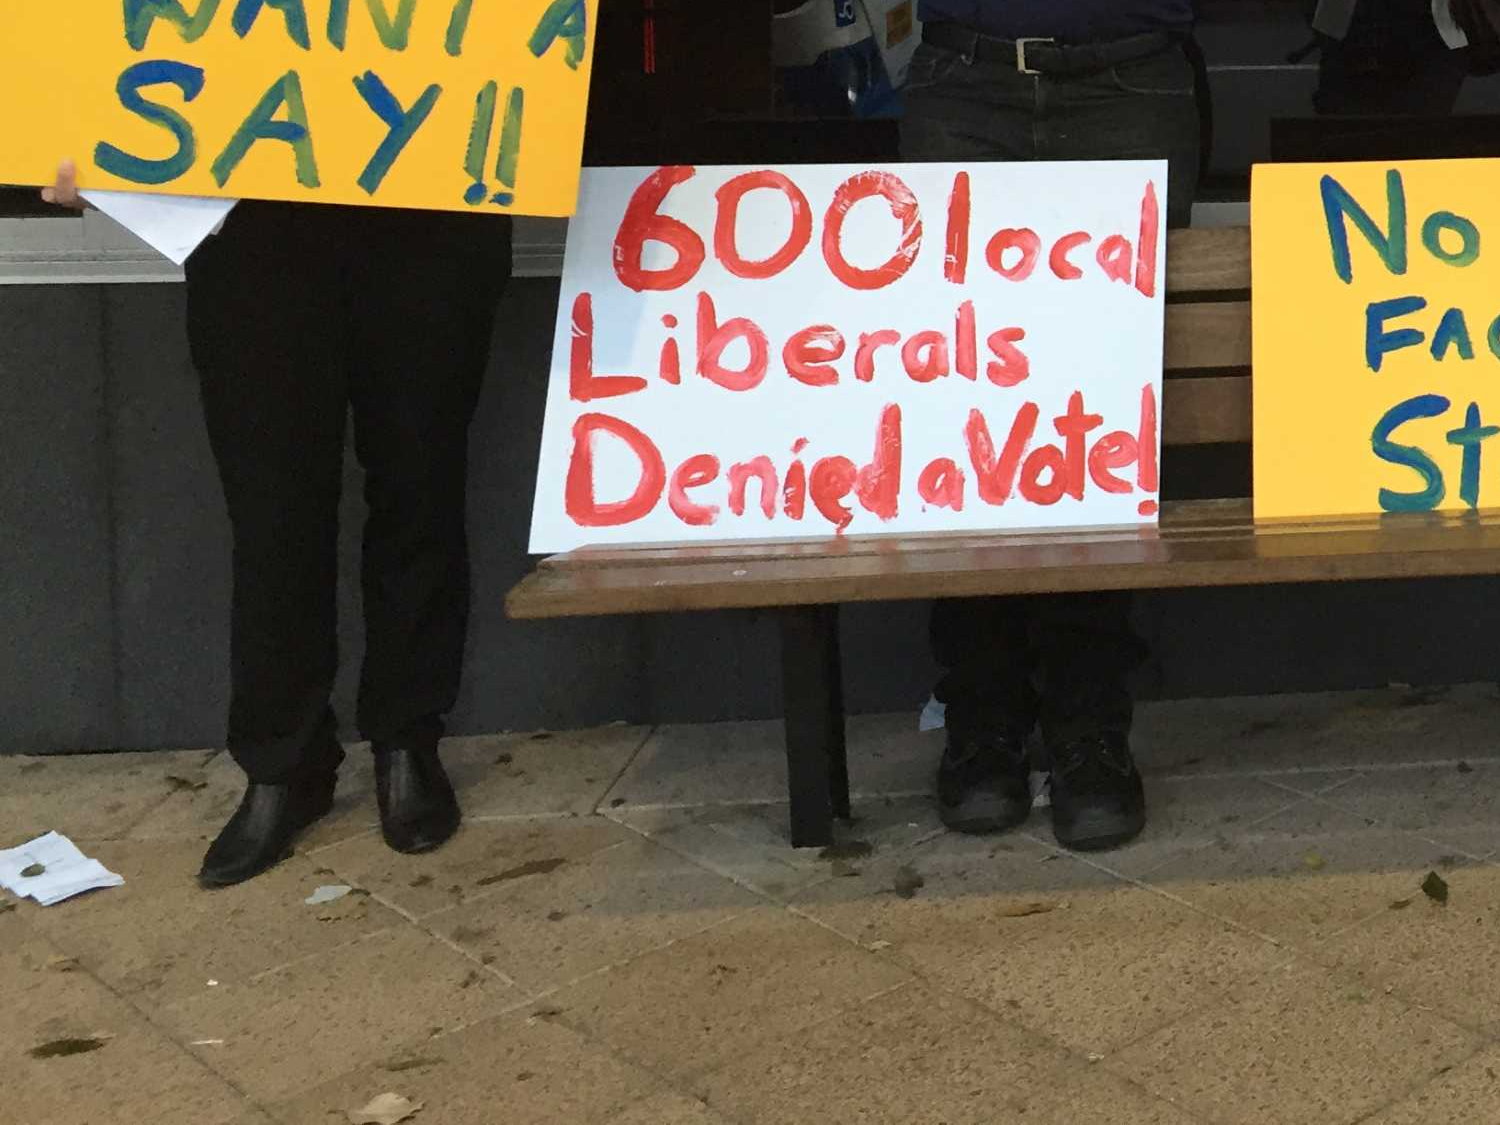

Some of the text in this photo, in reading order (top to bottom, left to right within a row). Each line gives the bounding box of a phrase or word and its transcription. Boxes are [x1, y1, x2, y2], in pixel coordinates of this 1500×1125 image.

[93, 59, 525, 207] SAY!!
[612, 165, 1156, 298] 600 local
[1320, 168, 1481, 284] No
[569, 291, 1031, 402] Liberals
[565, 382, 1158, 535] Denied a Vote!
